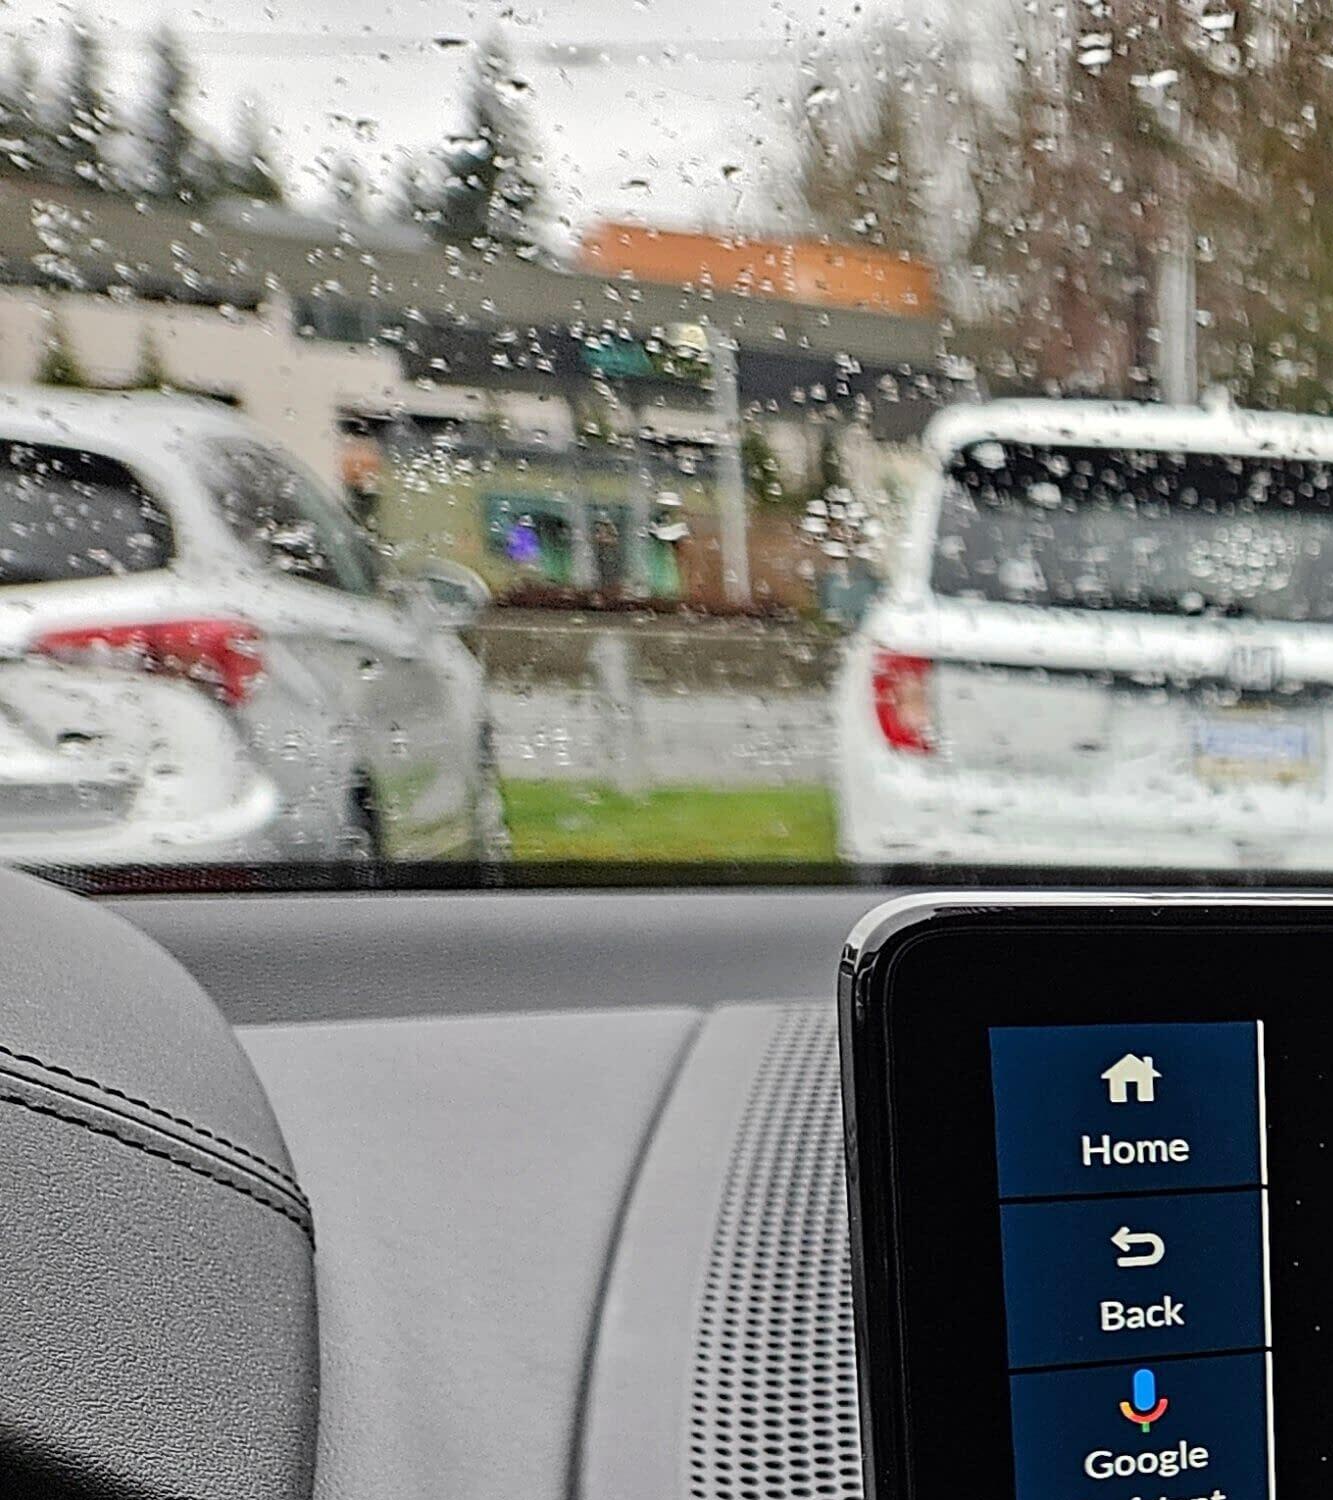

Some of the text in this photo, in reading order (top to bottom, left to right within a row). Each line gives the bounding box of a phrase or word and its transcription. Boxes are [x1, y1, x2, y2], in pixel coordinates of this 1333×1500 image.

[1081, 1134, 1190, 1166] Home
[1100, 1295, 1185, 1331] Back
[1084, 1439, 1209, 1479] Google
